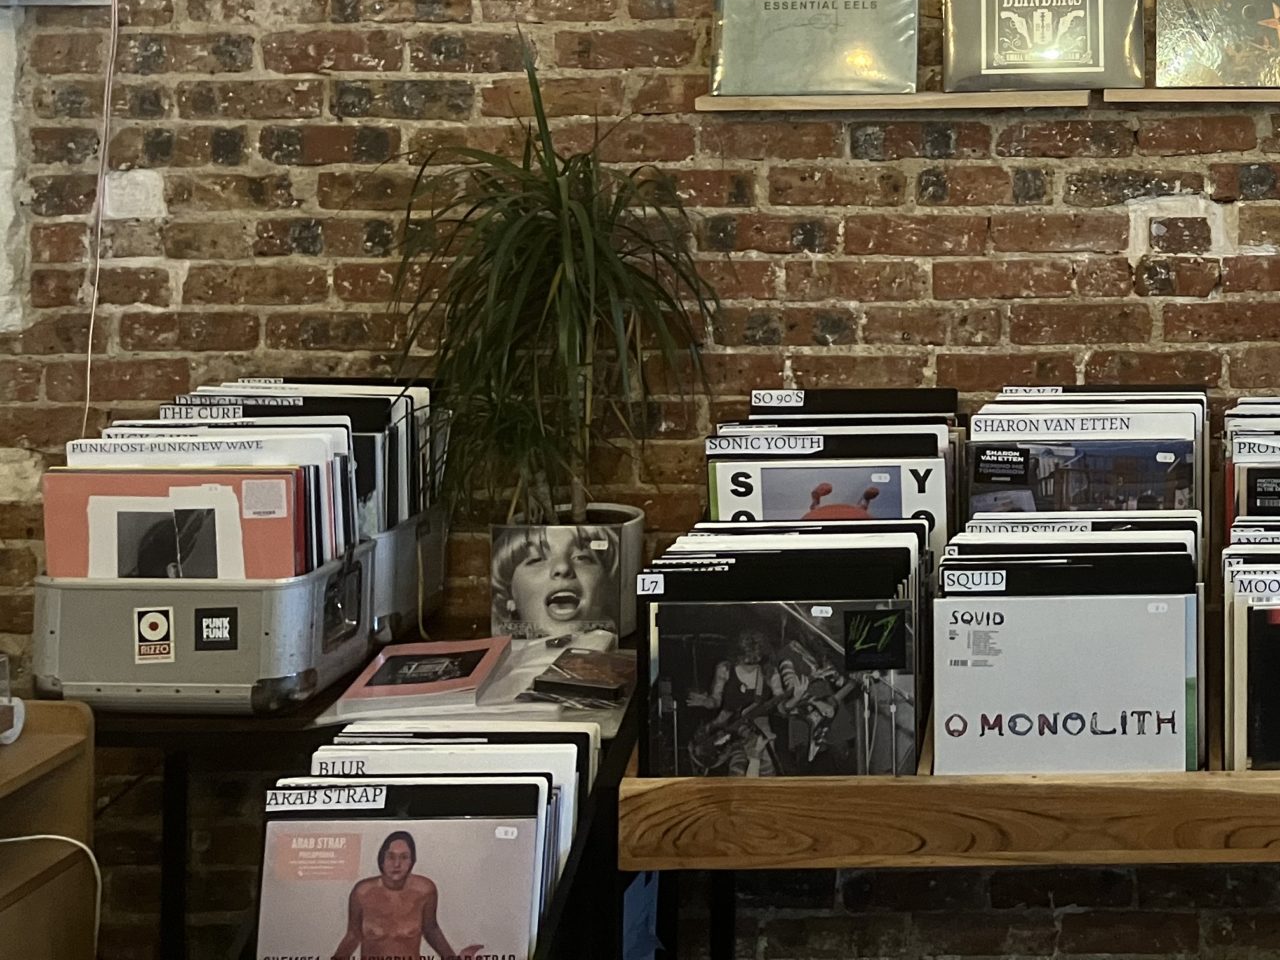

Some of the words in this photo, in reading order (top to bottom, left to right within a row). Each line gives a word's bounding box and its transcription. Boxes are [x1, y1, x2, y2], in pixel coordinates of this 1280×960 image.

[763, 1, 838, 10] ESSENTIAL
[843, 1, 878, 10] EELS
[753, 393, 773, 405] SO
[160, 406, 193, 419] THE
[198, 406, 241, 419] CURE
[974, 419, 1040, 432] SHARON
[1044, 419, 1076, 431] VAN
[1080, 417, 1131, 430] ETTEN
[225, 440, 263, 450] WAVE
[709, 437, 761, 450] SONIC
[763, 436, 821, 449] YOUTH
[641, 578, 659, 592] L7
[946, 572, 1004, 589] SQUID
[202, 617, 230, 630] PUNK
[949, 610, 1005, 626] SQUID
[203, 628, 230, 639] FUNK
[140, 645, 169, 654] RIZZO
[945, 714, 968, 738] O
[979, 710, 1177, 737] MONOLITH
[318, 760, 367, 775] BLUR
[267, 791, 318, 806] ARAB
[322, 787, 383, 803] STRAP
